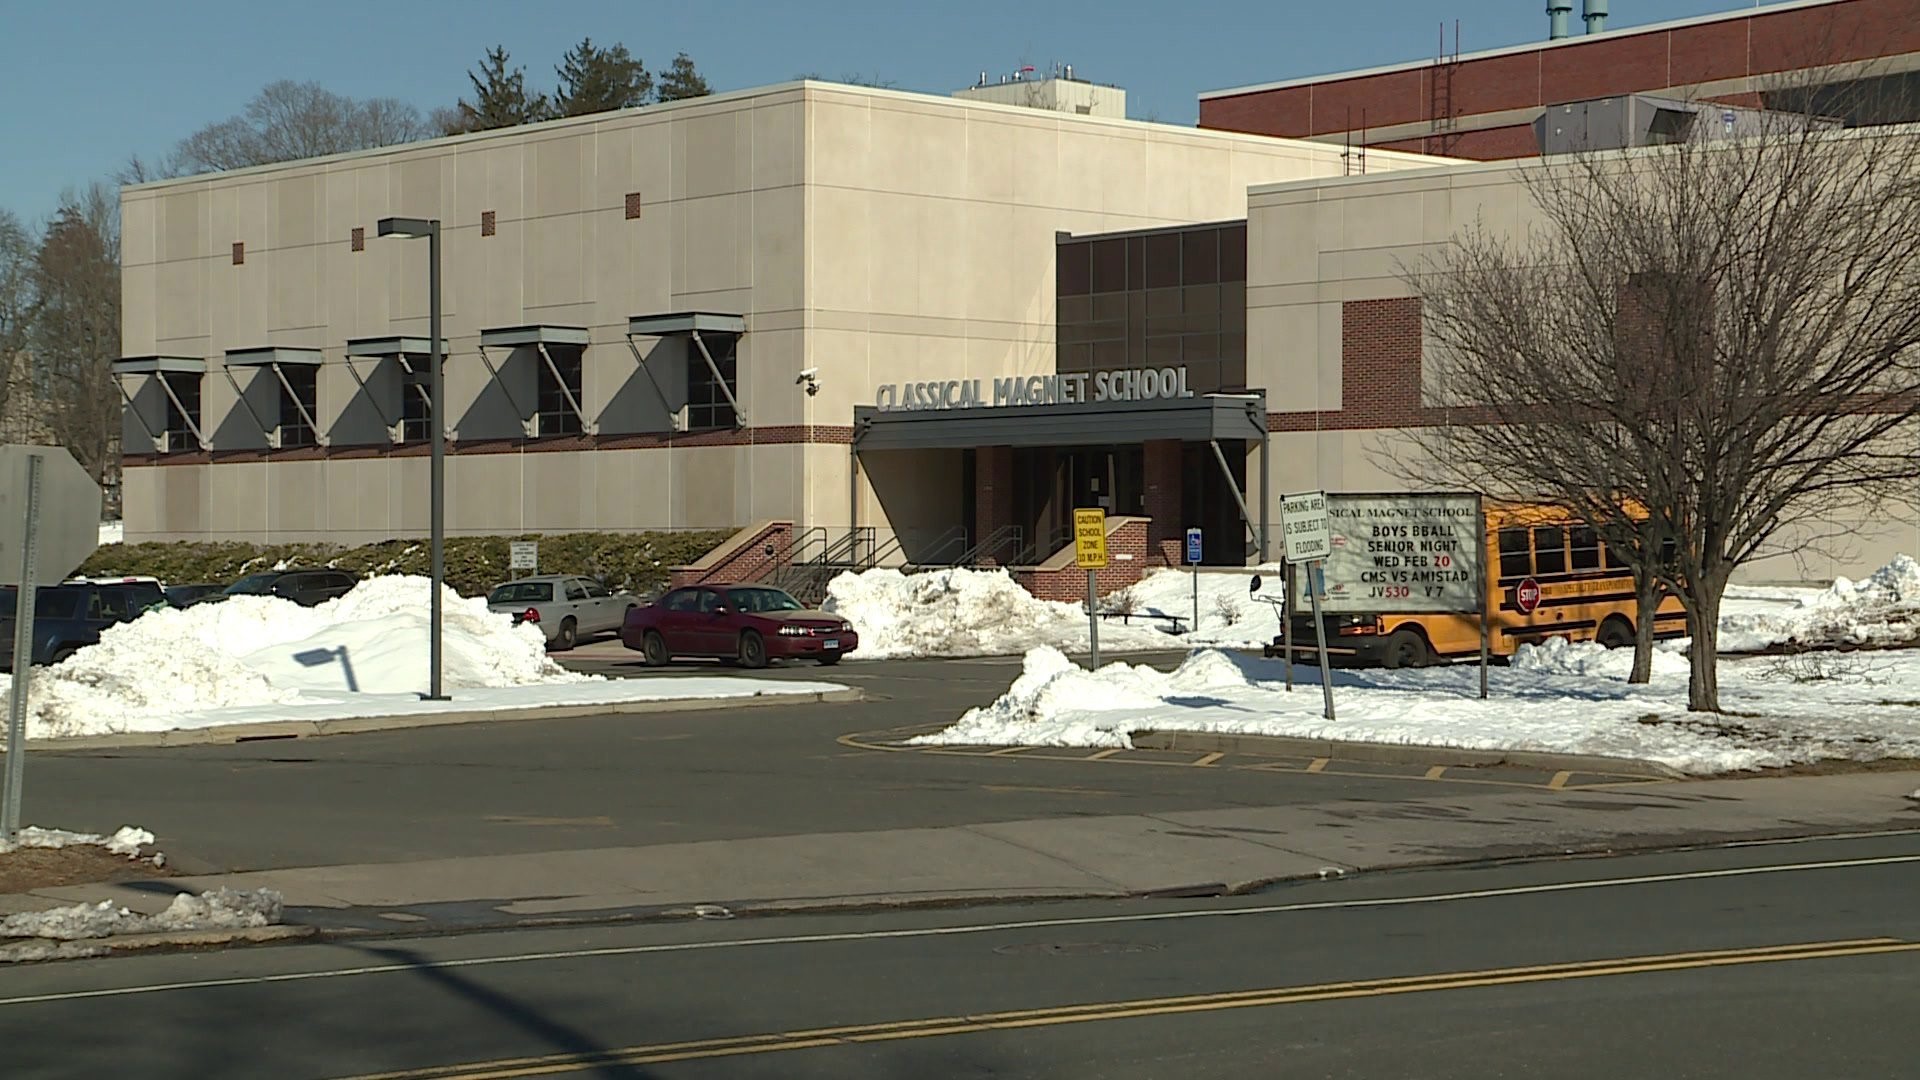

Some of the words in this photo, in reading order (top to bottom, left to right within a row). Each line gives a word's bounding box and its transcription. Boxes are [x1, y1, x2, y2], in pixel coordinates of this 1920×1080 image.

[876, 379, 986, 412] CLASSICAL
[993, 373, 1089, 406] MAGNET
[1095, 367, 1194, 402] SCHOOL
[1283, 500, 1309, 514] PARKING
[1311, 498, 1324, 510] AREA
[1329, 508, 1364, 518] SICAL
[1367, 508, 1418, 518] MAGNET
[1422, 508, 1474, 517] SCHOOL
[1078, 515, 1101, 525] CAUTION
[1079, 528, 1101, 537] SCHOOL
[1286, 522, 1292, 535] IS
[1294, 519, 1319, 533] SUBJECT
[1320, 518, 1327, 530] TO
[1373, 525, 1407, 537] BOYS
[1412, 525, 1454, 537] BBALL
[1083, 540, 1098, 550] ZONE
[1296, 539, 1323, 554] FLOODING
[1368, 540, 1414, 552] SENIOR
[1420, 540, 1457, 552] NIGHT
[1079, 553, 1086, 562] 10
[1374, 556, 1399, 567] WED
[1405, 556, 1428, 567] FEB
[1434, 556, 1450, 567] 20
[1361, 571, 1387, 583] CMS
[1392, 571, 1407, 582] VS
[1411, 571, 1469, 582] AMISTAD
[1425, 586, 1432, 597] V
[1436, 586, 1444, 597] 7
[1520, 588, 1538, 601] STOP
